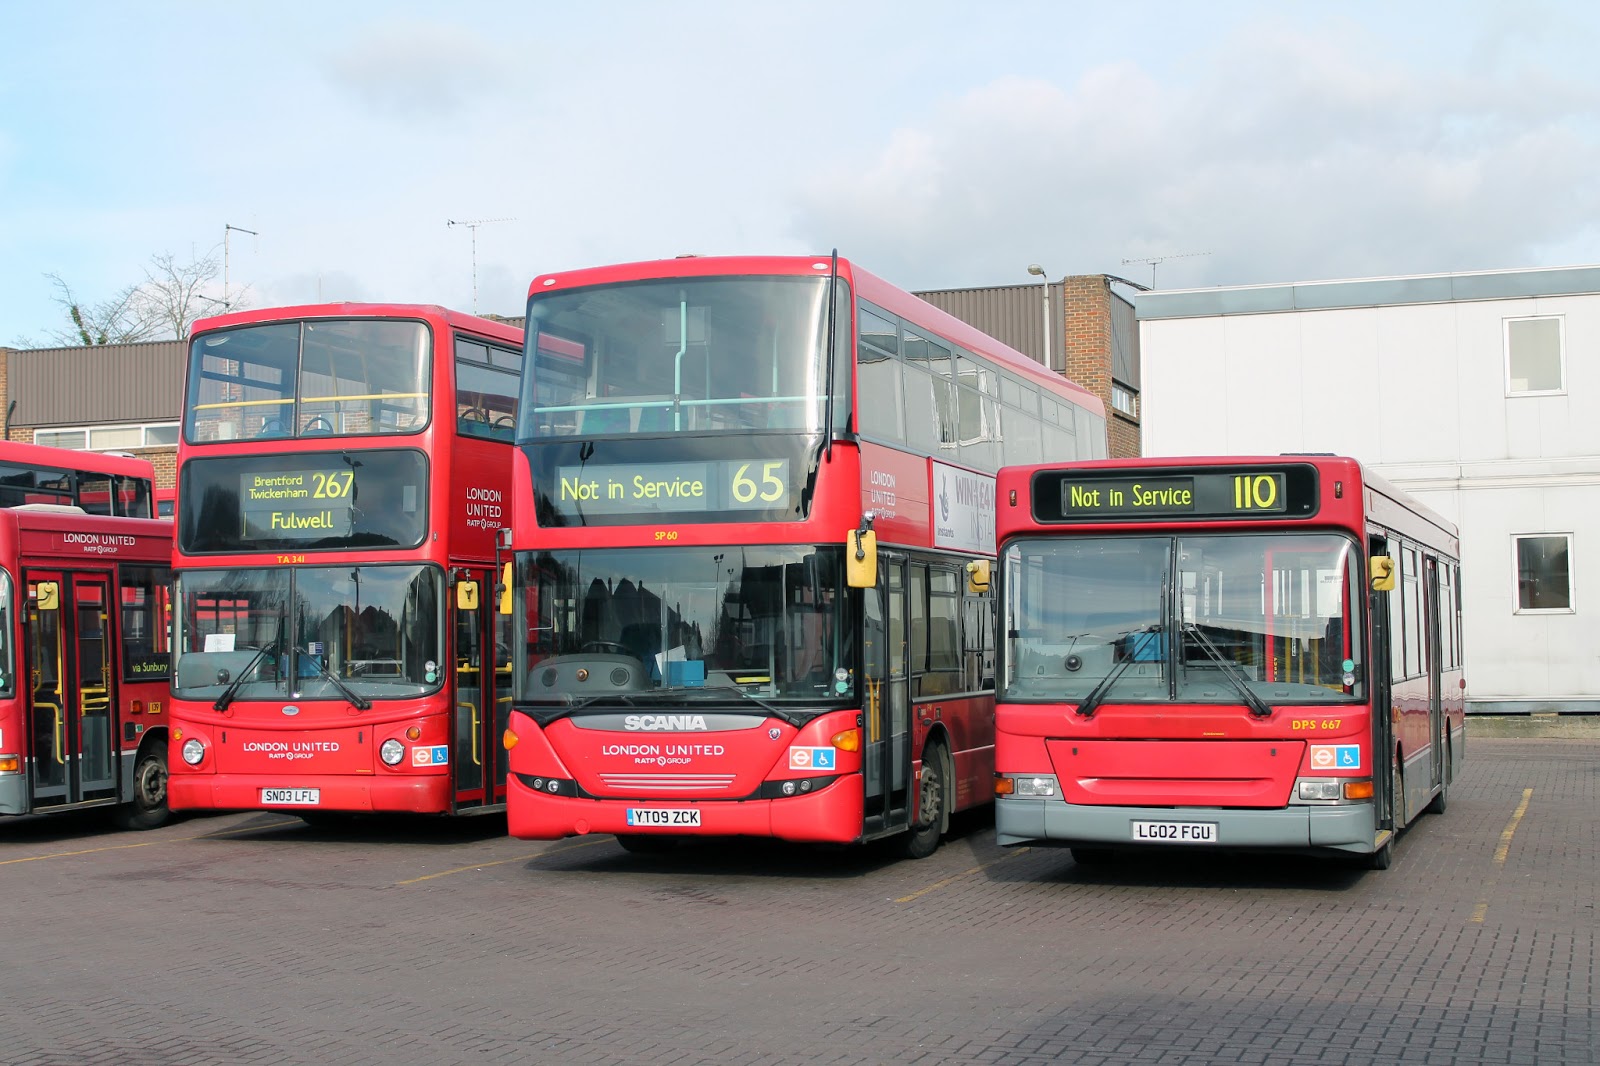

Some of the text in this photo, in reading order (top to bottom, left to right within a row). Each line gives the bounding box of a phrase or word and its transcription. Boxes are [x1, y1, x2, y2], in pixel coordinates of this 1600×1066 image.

[254, 475, 303, 487] Brentford
[312, 471, 354, 499] 267
[732, 462, 784, 503] 65
[870, 470, 896, 488] LONDON
[249, 488, 308, 499] Twickenham
[466, 487, 502, 502] LONDON
[561, 475, 703, 501] Not in Service
[1234, 475, 1276, 508] 110
[871, 489, 896, 506] UNITED
[1071, 484, 1191, 507] Not in Service
[466, 503, 502, 518] UNITED
[271, 511, 334, 529] Fulwell
[466, 519, 480, 527] RATP
[63, 533, 136, 546] LONDON UNITED
[655, 531, 678, 540] SP 60
[277, 555, 305, 564] TA 341
[132, 662, 168, 673] via Sunbury
[624, 715, 708, 730] SCANIA
[1292, 719, 1342, 730] DPS 667
[243, 742, 340, 751] LONDON UNITED
[602, 745, 724, 755] LONDON UNITED
[266, 790, 315, 802] SN03 LFL
[635, 810, 698, 823] YT09 ZCK
[1139, 824, 1210, 839] LG02 FGU
